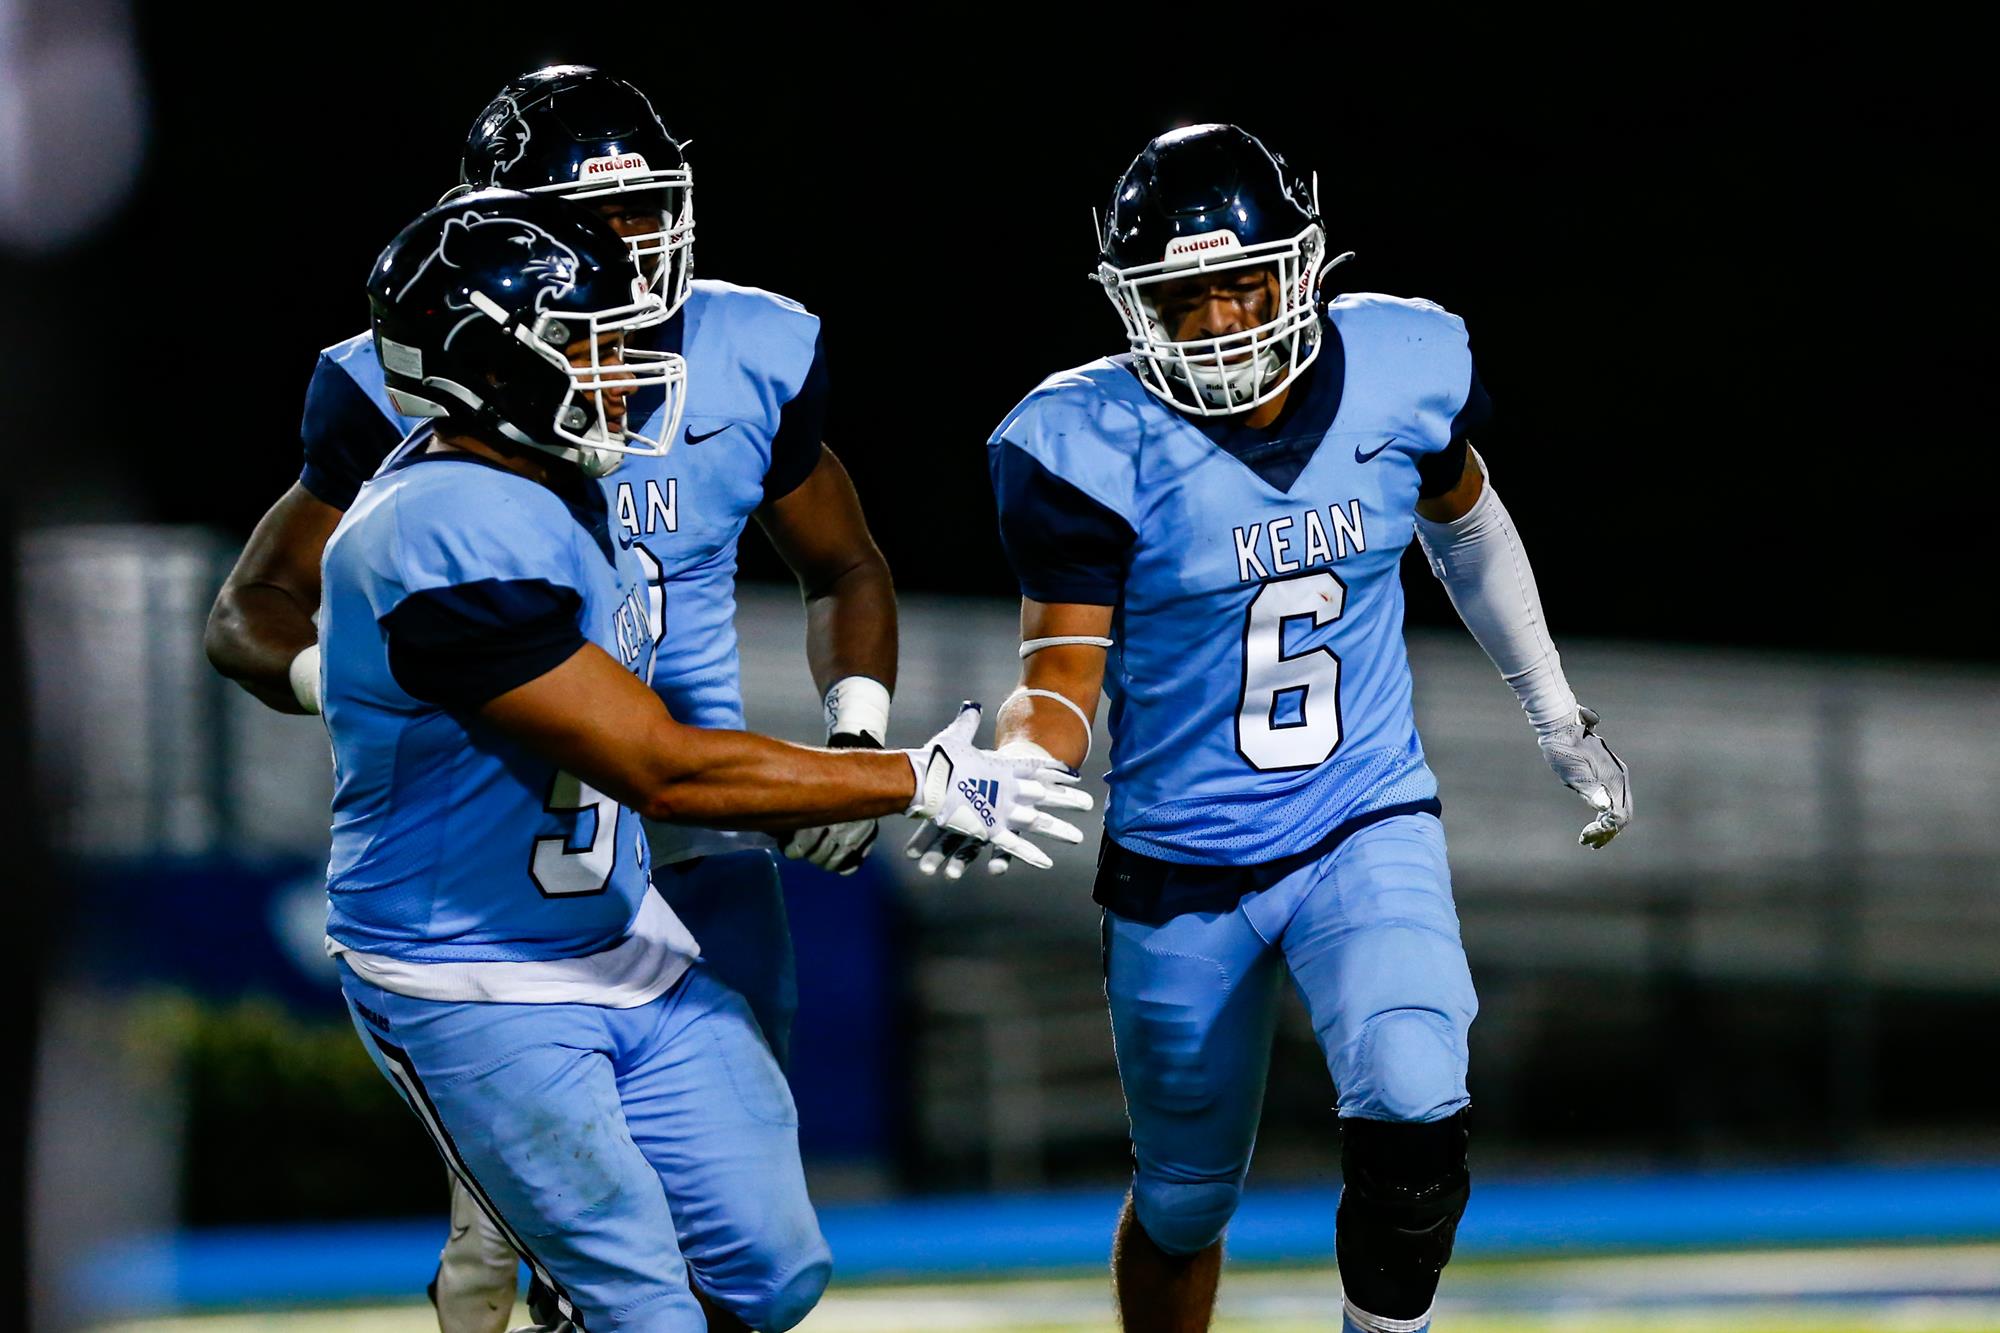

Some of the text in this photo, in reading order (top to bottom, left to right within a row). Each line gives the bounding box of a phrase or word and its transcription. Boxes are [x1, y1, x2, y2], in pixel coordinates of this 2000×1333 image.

[587, 158, 642, 174] Riddell
[1172, 236, 1230, 255] Riddell
[617, 478, 678, 536] AN
[1233, 499, 1366, 582] KEAN
[612, 583, 654, 666] KEAN
[1234, 567, 1348, 773] 6
[957, 780, 997, 828] adidas
